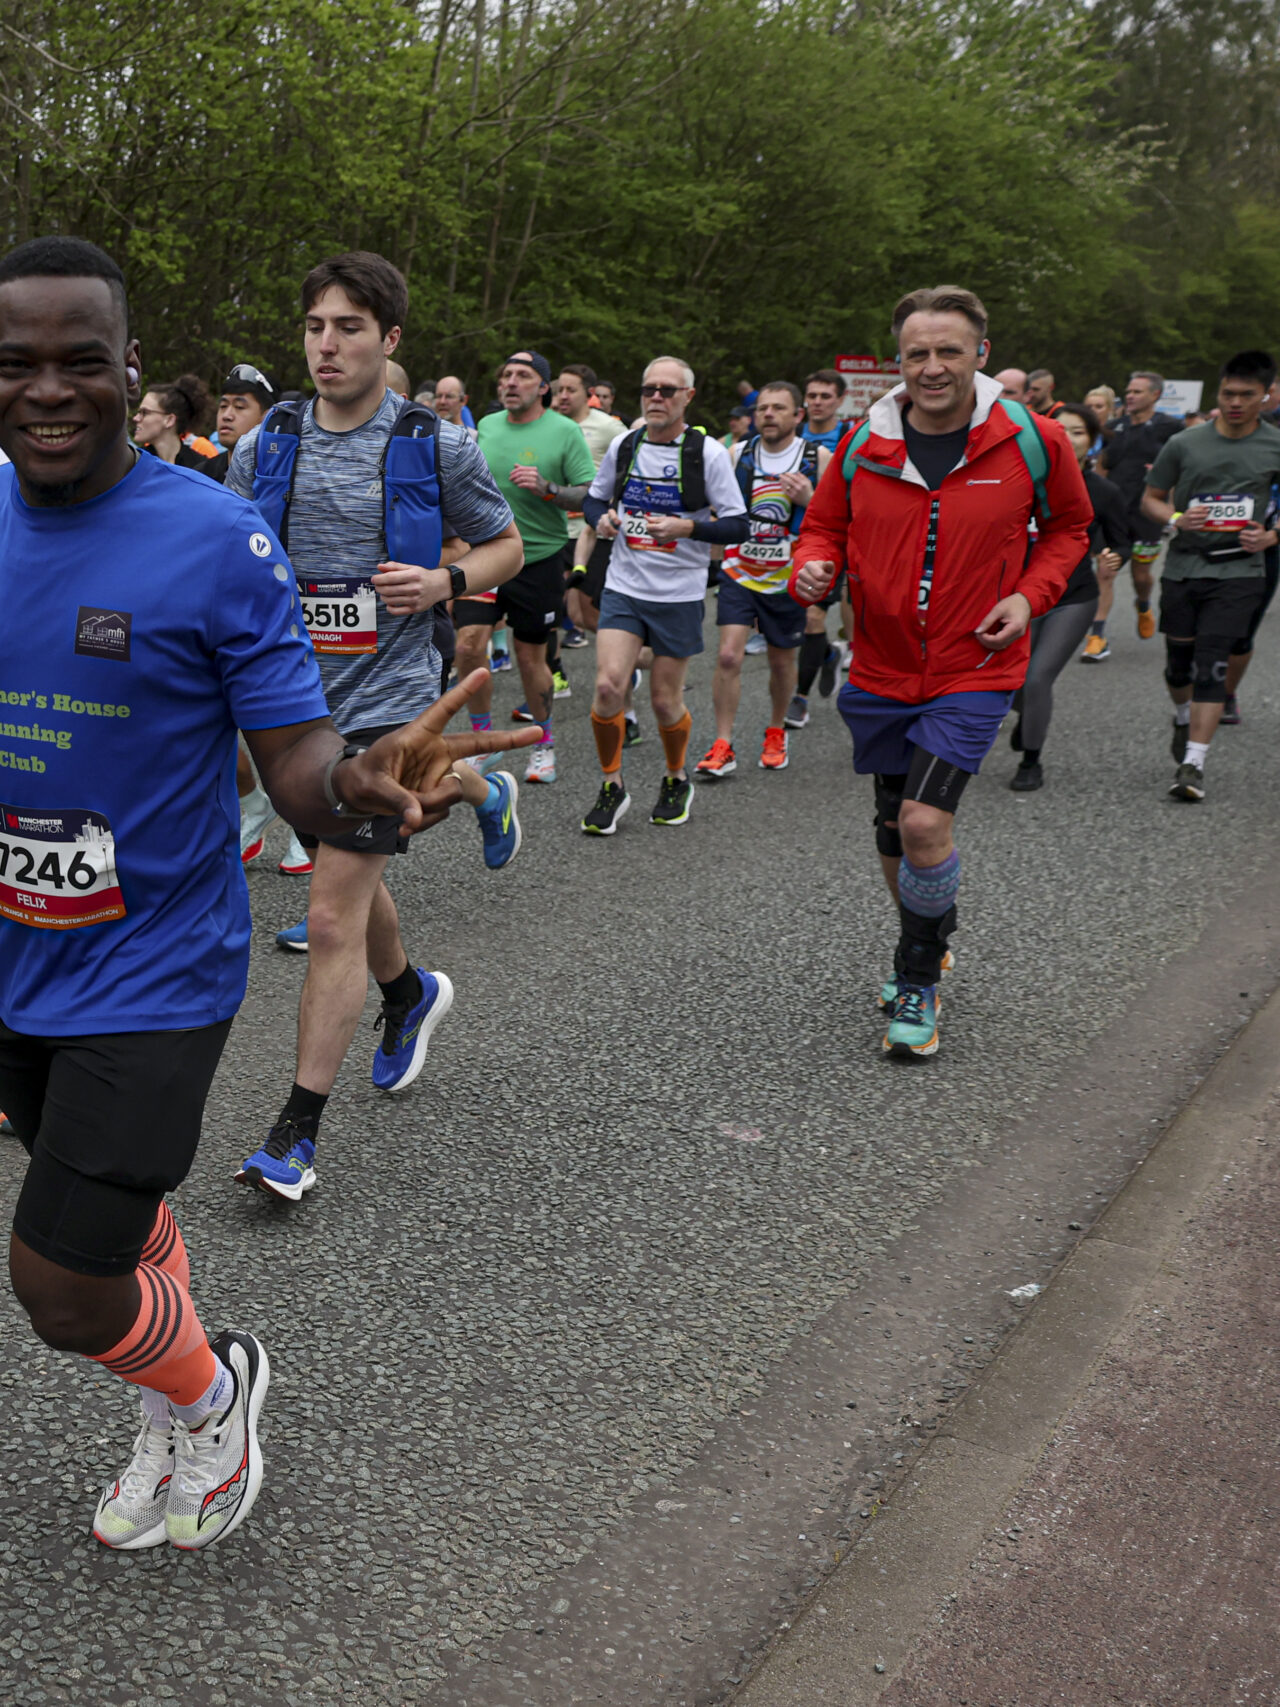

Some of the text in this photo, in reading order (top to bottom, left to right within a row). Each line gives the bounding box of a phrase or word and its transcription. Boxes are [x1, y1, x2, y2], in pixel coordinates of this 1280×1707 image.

[743, 544, 785, 558] 24974
[108, 627, 125, 639] mfh
[53, 693, 131, 718] House
[18, 816, 63, 826] MANCHESTER
[18, 822, 64, 833] MARATHON
[16, 892, 48, 910] FELIX
